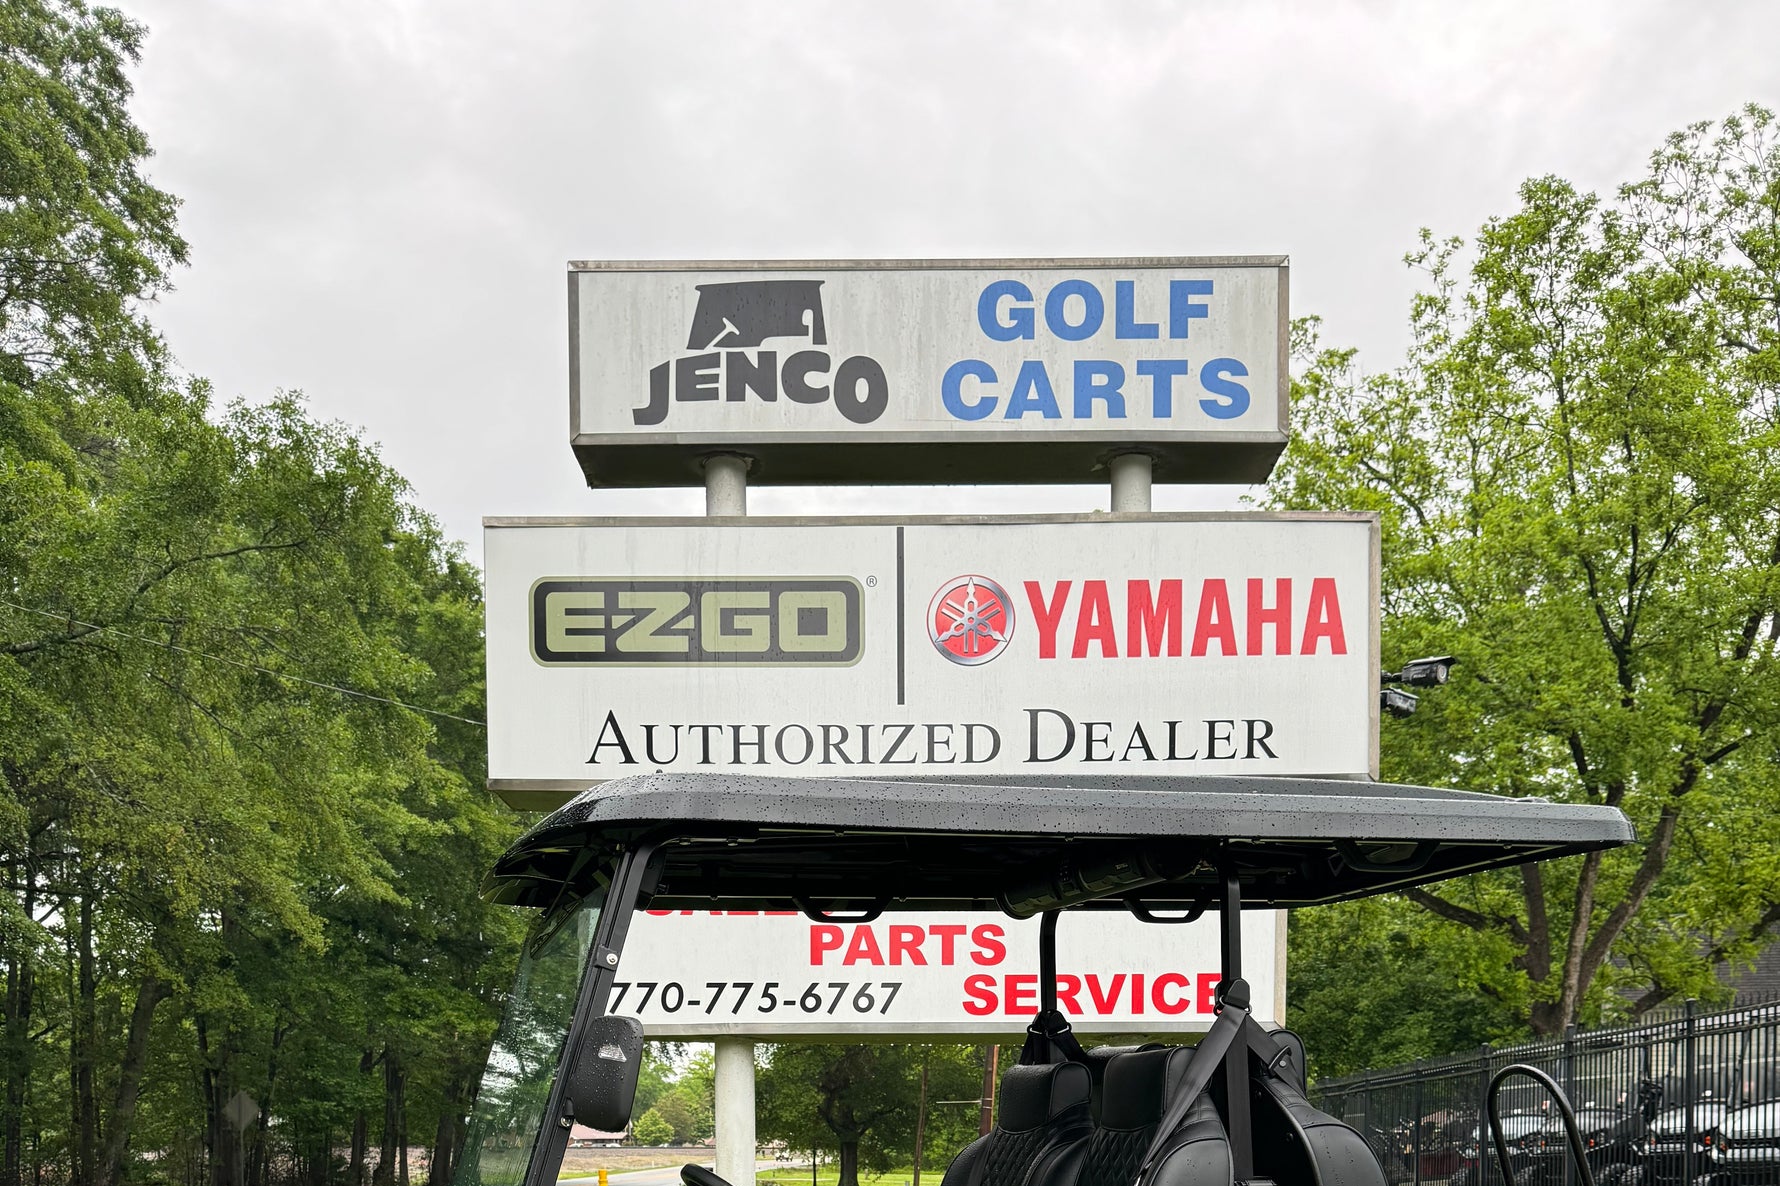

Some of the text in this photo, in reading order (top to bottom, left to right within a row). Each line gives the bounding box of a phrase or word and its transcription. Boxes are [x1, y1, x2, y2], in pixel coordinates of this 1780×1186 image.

[977, 279, 1214, 342] GOLF
[632, 350, 889, 426] JENCO
[941, 358, 1251, 421] CARTS
[1023, 577, 1348, 660] YAMAHA
[585, 707, 1280, 766] AUTHORIZED DEALER
[809, 923, 1007, 967] PARTS
[608, 982, 903, 1015] 770-775-6767
